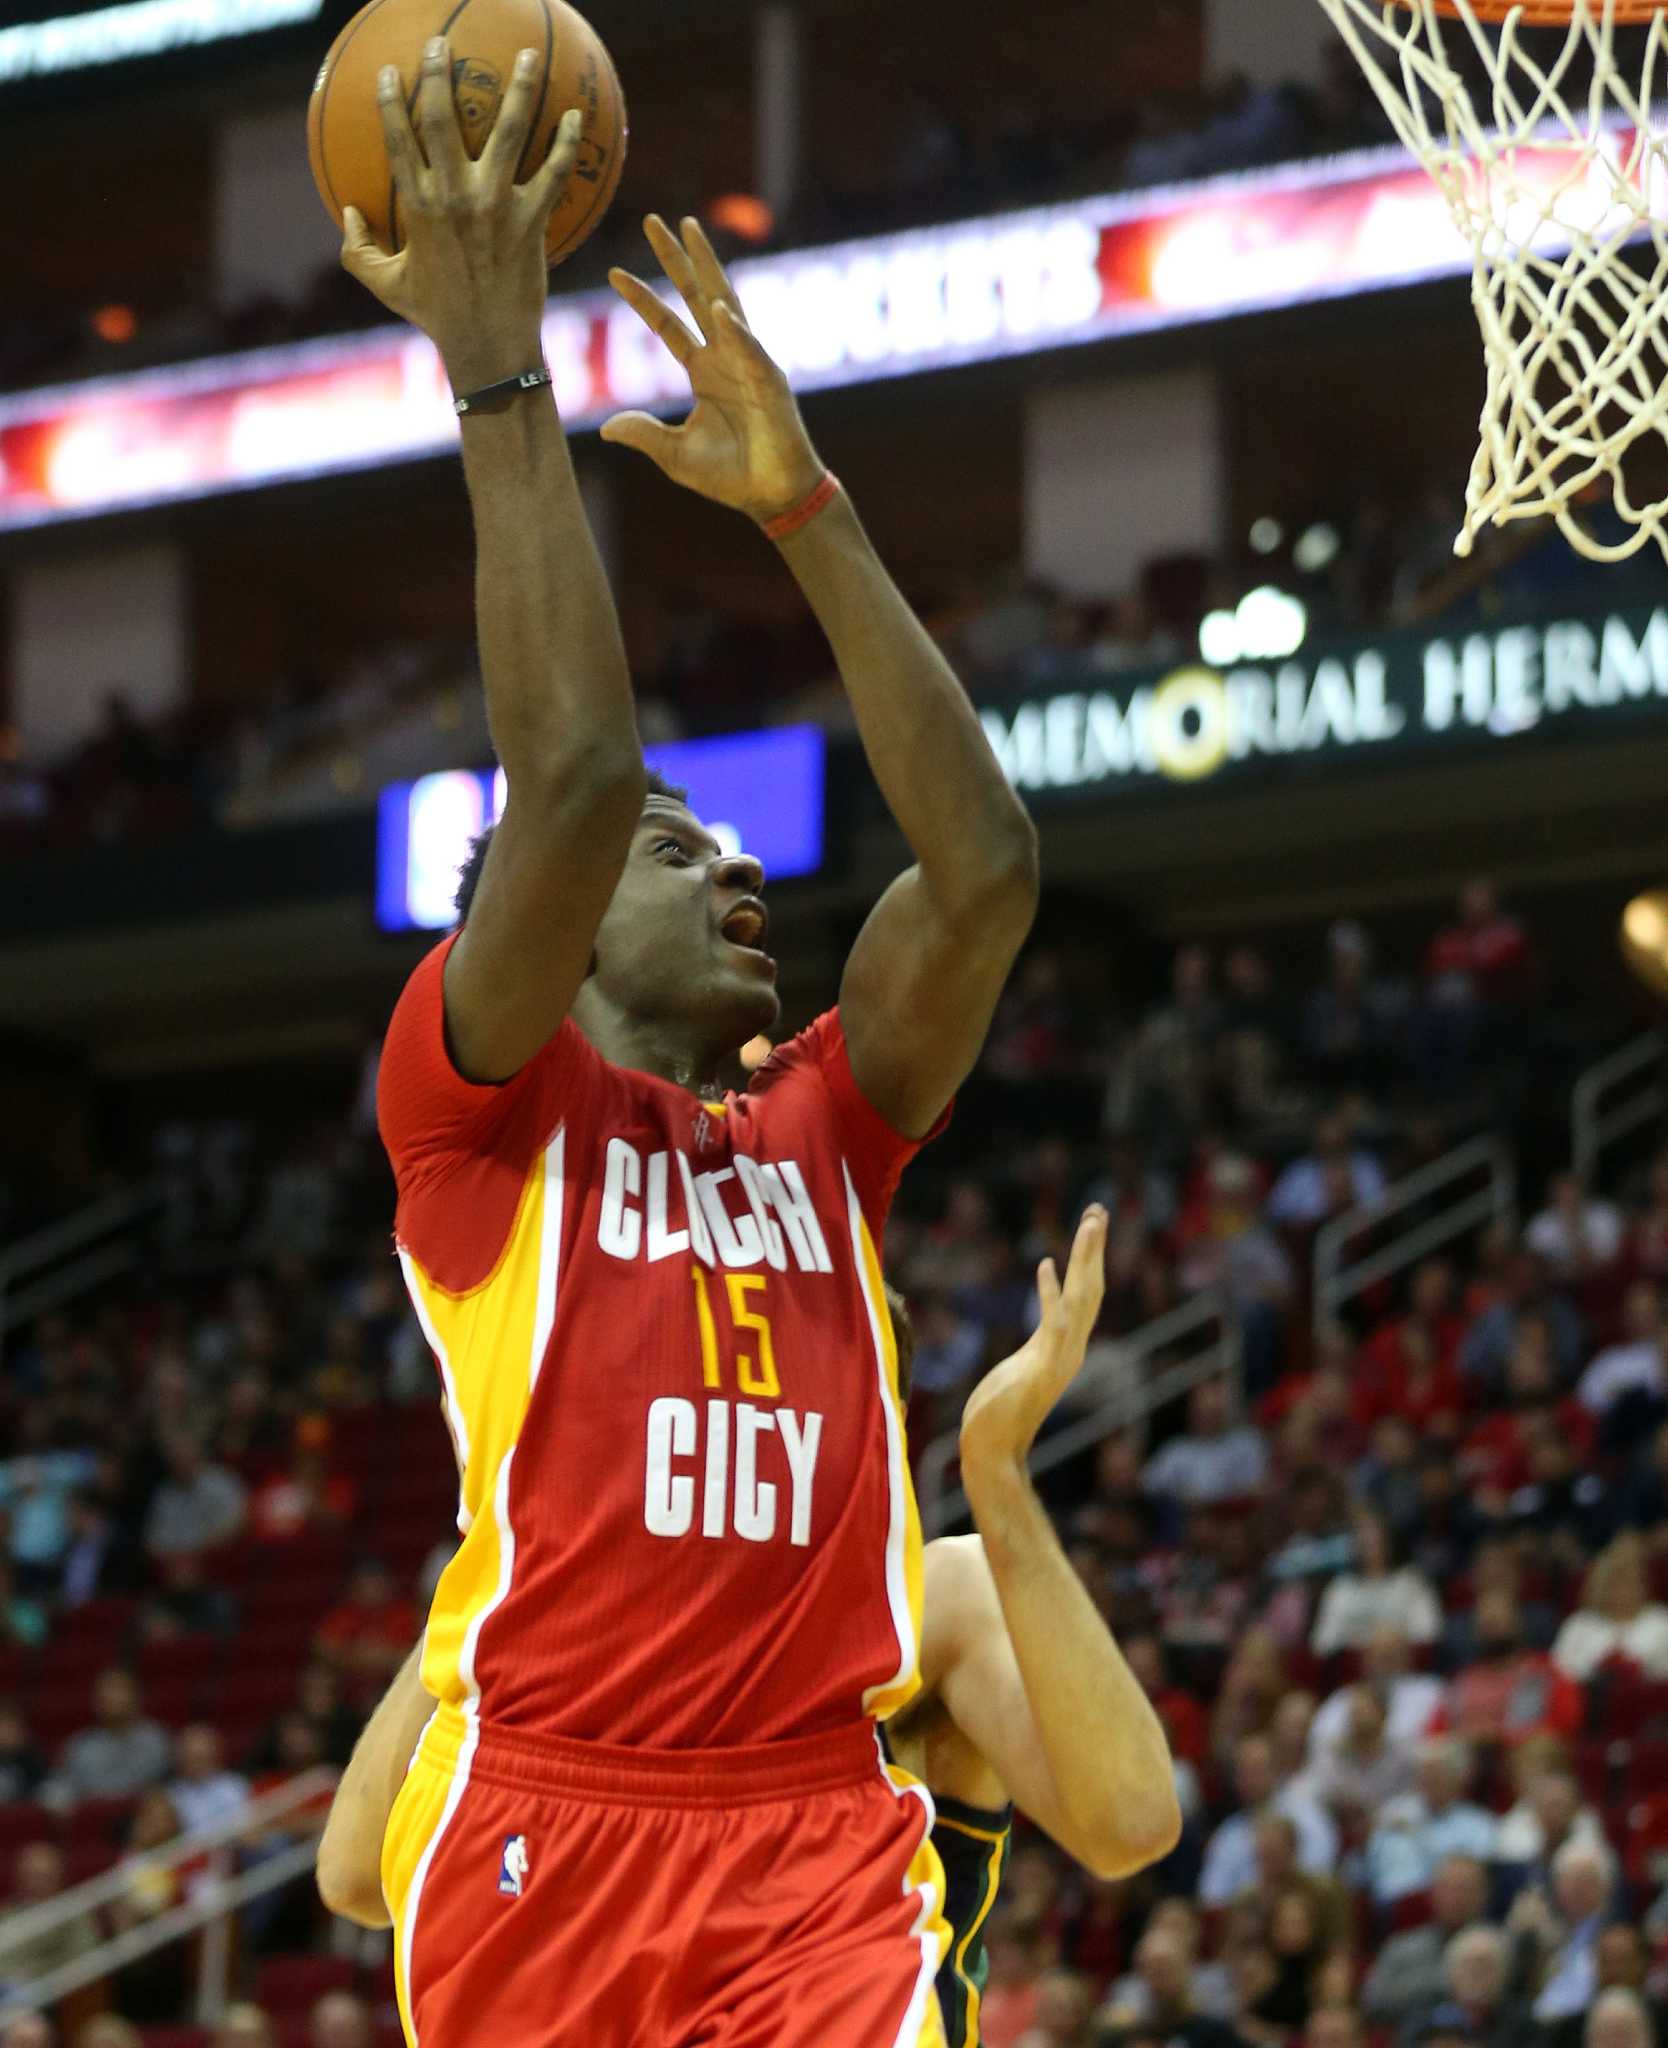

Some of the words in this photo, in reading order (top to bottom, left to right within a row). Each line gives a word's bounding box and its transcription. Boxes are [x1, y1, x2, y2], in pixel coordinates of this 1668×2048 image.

[979, 650, 1404, 789] MEMORIAL
[691, 1265, 781, 1397] 15
[644, 1397, 823, 1546] CITY
